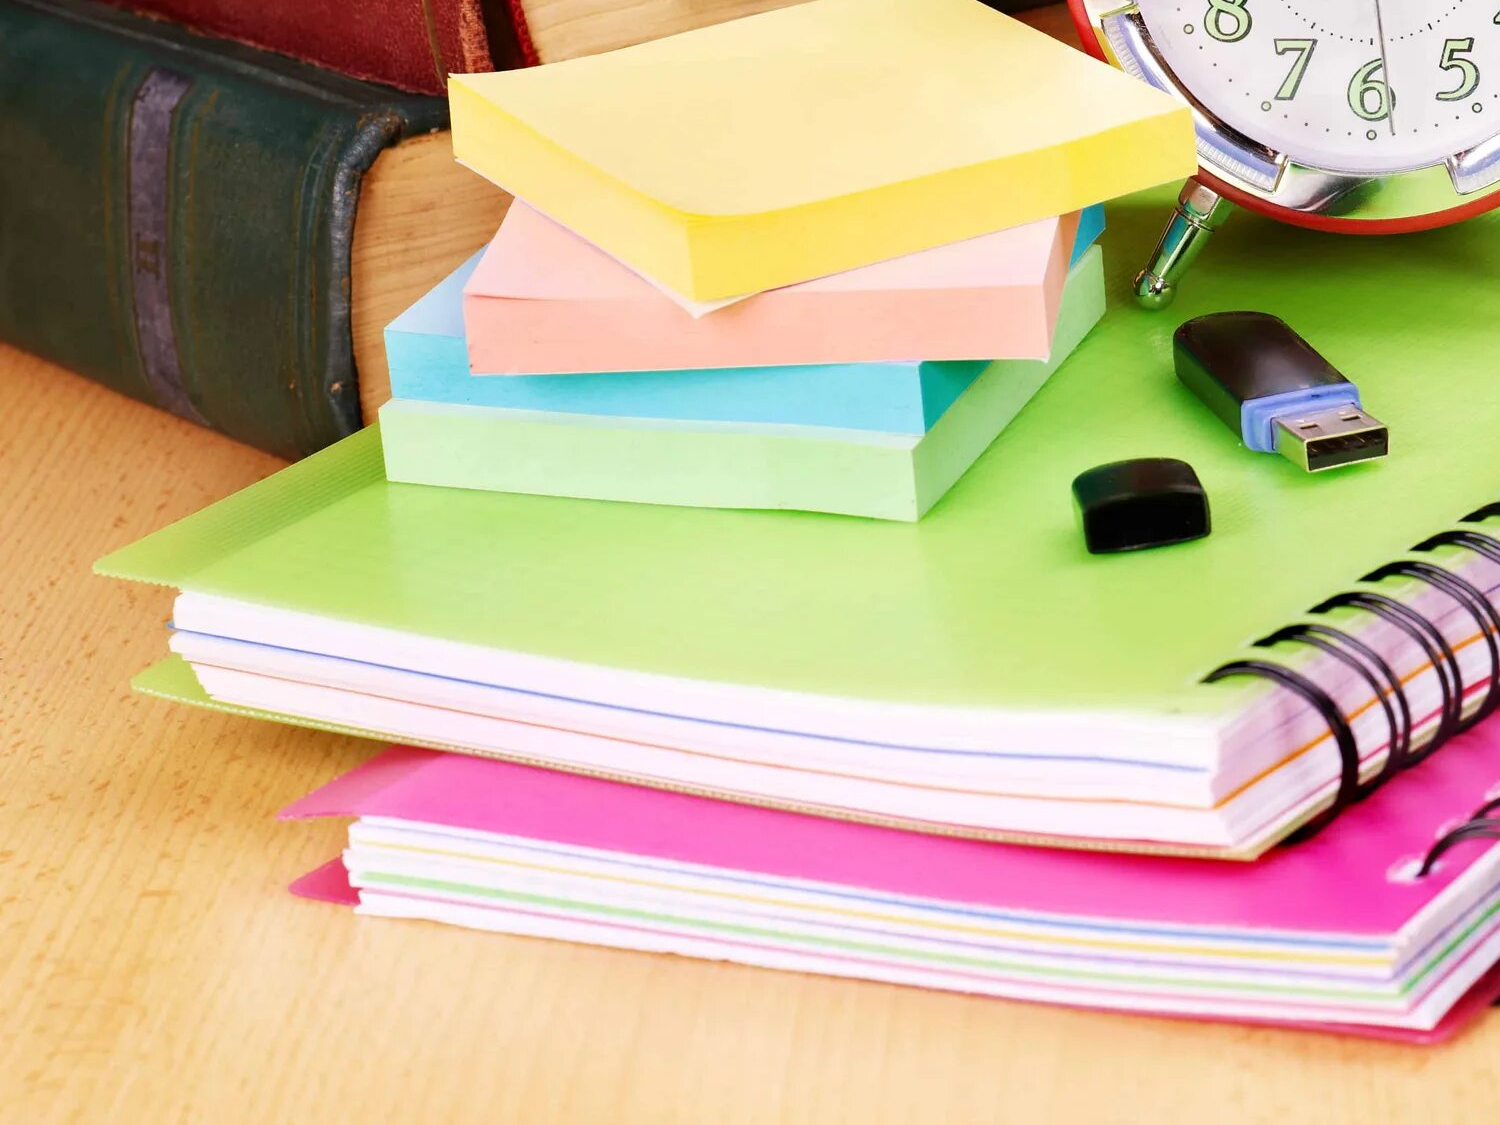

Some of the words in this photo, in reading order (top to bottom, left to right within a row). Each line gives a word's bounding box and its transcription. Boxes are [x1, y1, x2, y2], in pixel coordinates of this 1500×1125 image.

[1273, 38, 1318, 101] 7
[1346, 58, 1396, 123] 6
[1435, 37, 1481, 101] 5
